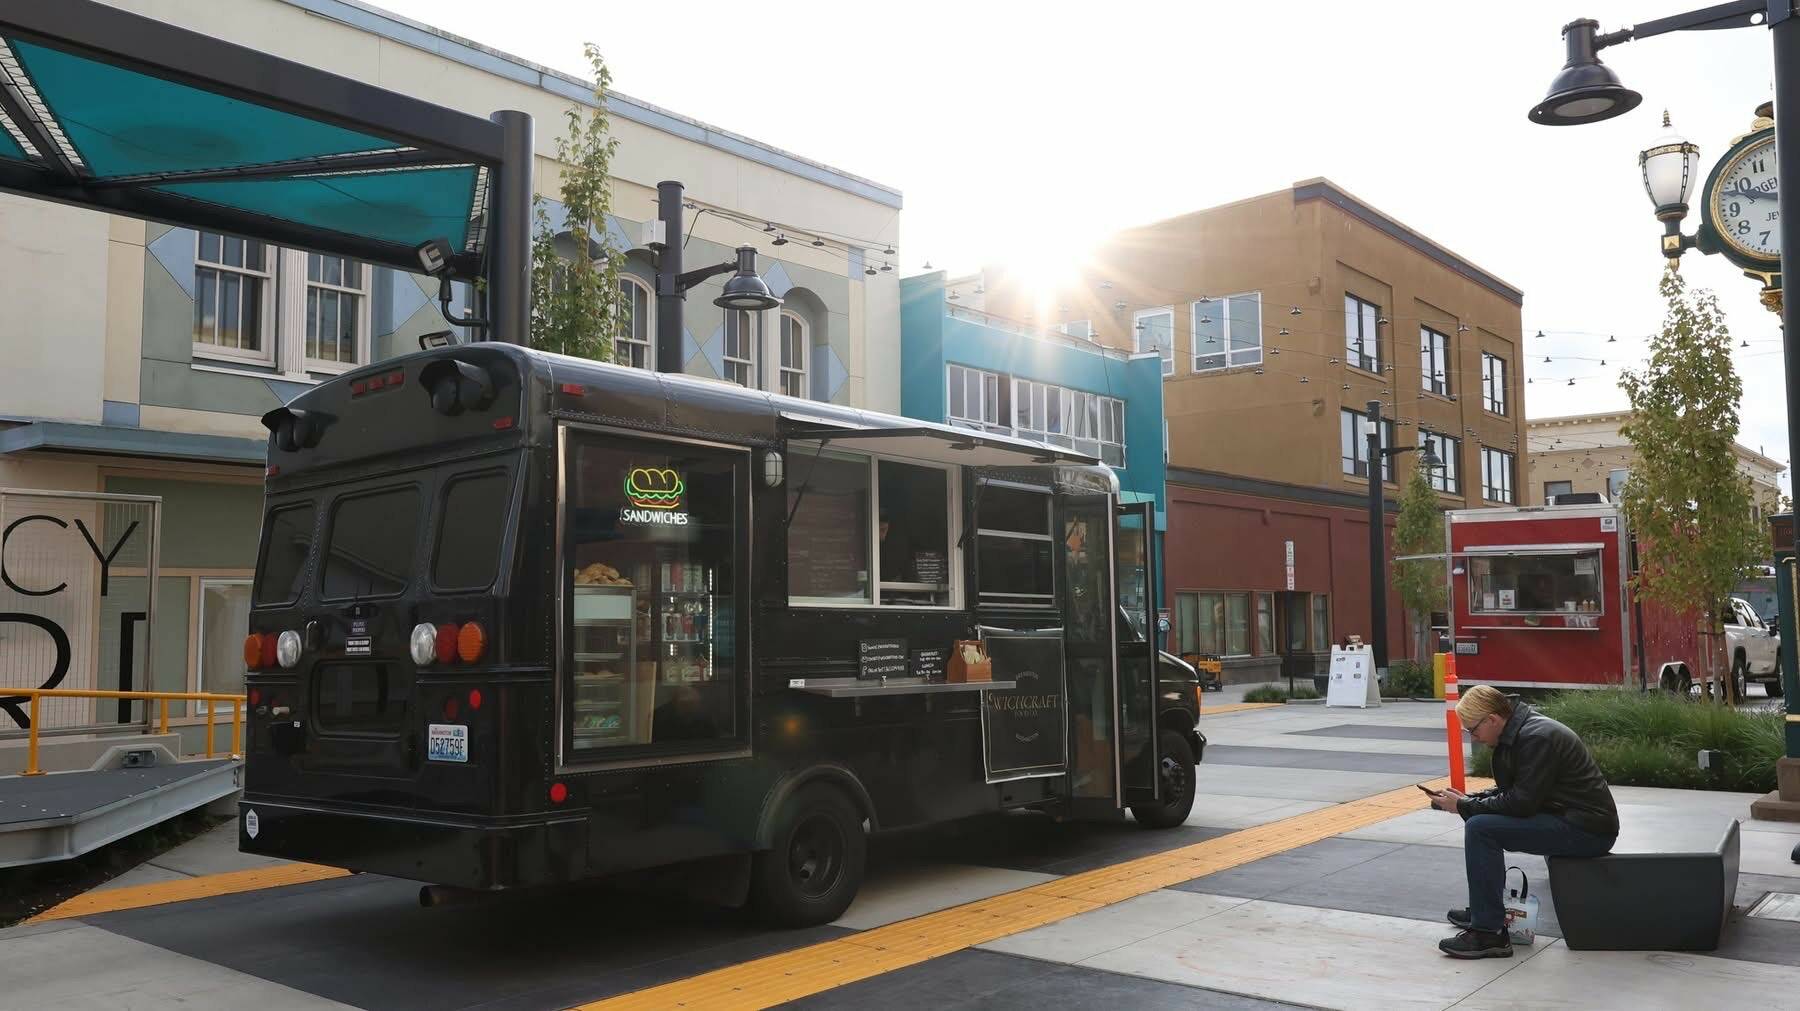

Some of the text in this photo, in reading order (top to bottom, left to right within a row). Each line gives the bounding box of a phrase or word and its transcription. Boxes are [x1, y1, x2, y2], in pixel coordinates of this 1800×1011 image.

[1752, 159, 1765, 173] 11
[1733, 177, 1752, 193] 10
[1729, 202, 1741, 218] 9
[1738, 219, 1751, 235] 8
[1759, 230, 1771, 246] 7
[623, 509, 688, 525] SANDWICHES
